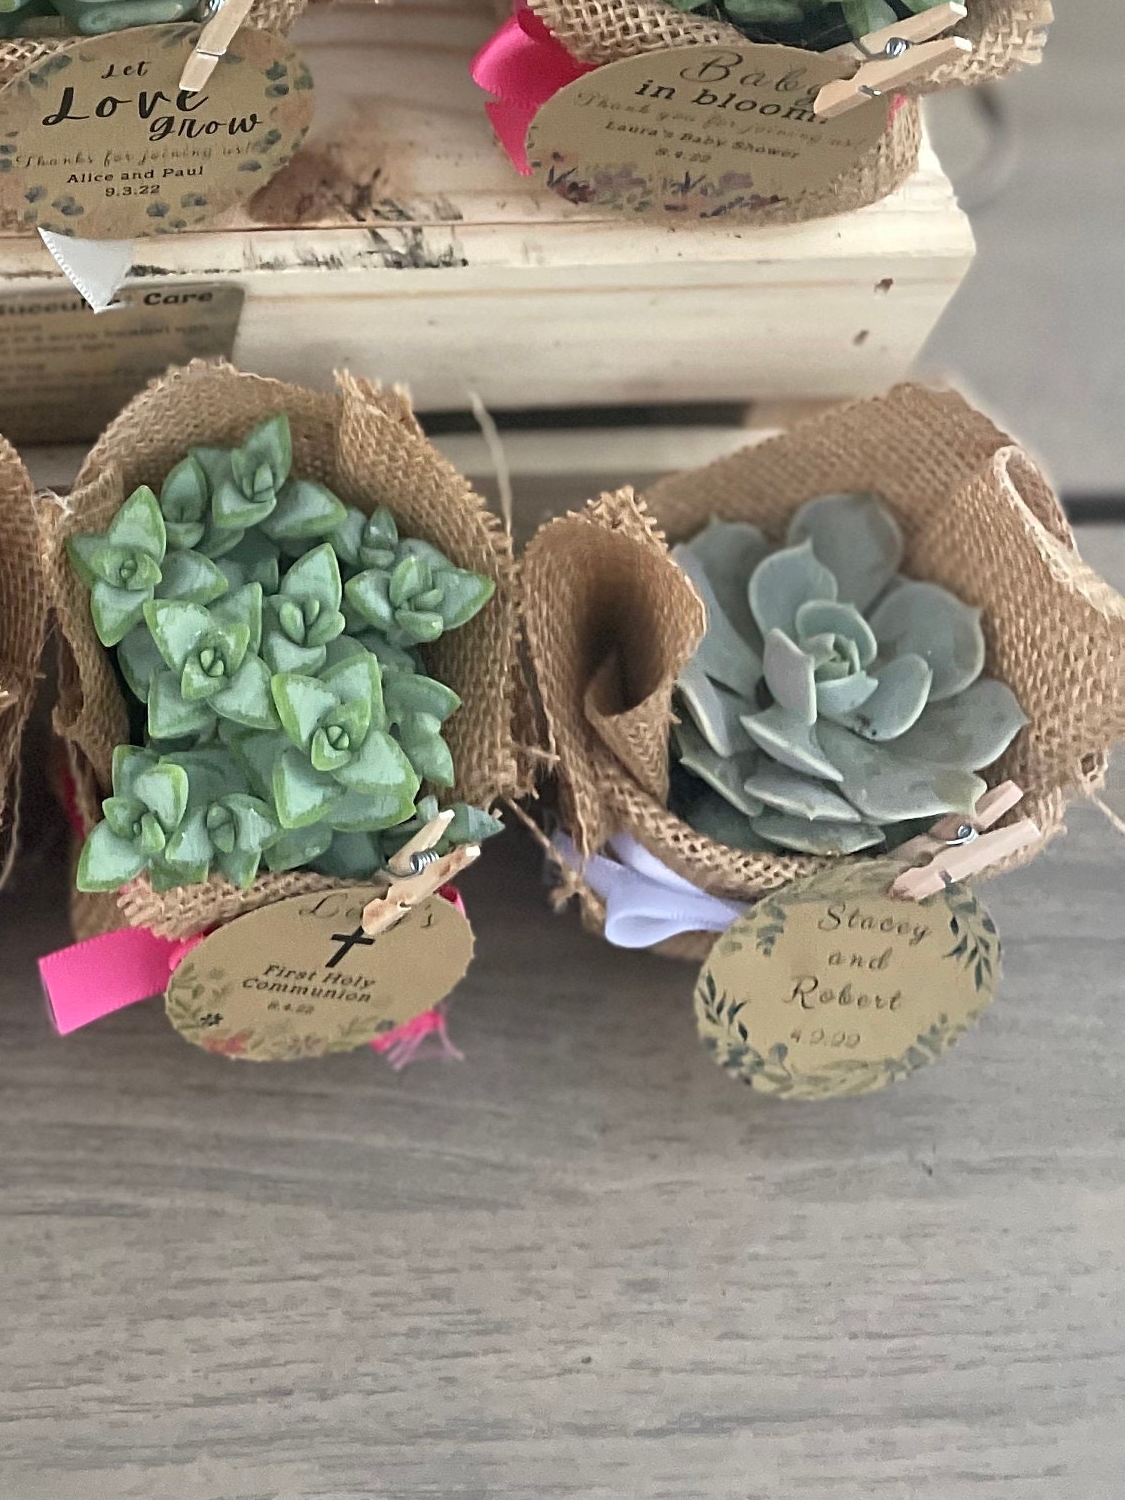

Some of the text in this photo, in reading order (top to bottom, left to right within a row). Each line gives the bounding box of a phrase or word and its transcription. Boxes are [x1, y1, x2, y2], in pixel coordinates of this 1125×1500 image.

[100, 59, 154, 80] Let
[634, 78, 676, 100] in
[41, 85, 211, 127] Love
[577, 89, 651, 115] Thank
[657, 108, 697, 123] you
[147, 111, 264, 142] grow
[604, 119, 802, 160] Laura's Baby Shower
[15, 140, 253, 169] Thanks for joining us!
[66, 165, 205, 185] Alice and Paul
[104, 183, 162, 199] 9.3.22
[142, 290, 215, 306] Care
[818, 903, 931, 947] Stacey
[828, 946, 894, 971] and
[241, 977, 373, 1003] Communion
[262, 963, 377, 990] First Holy
[783, 974, 902, 1011] Robert
